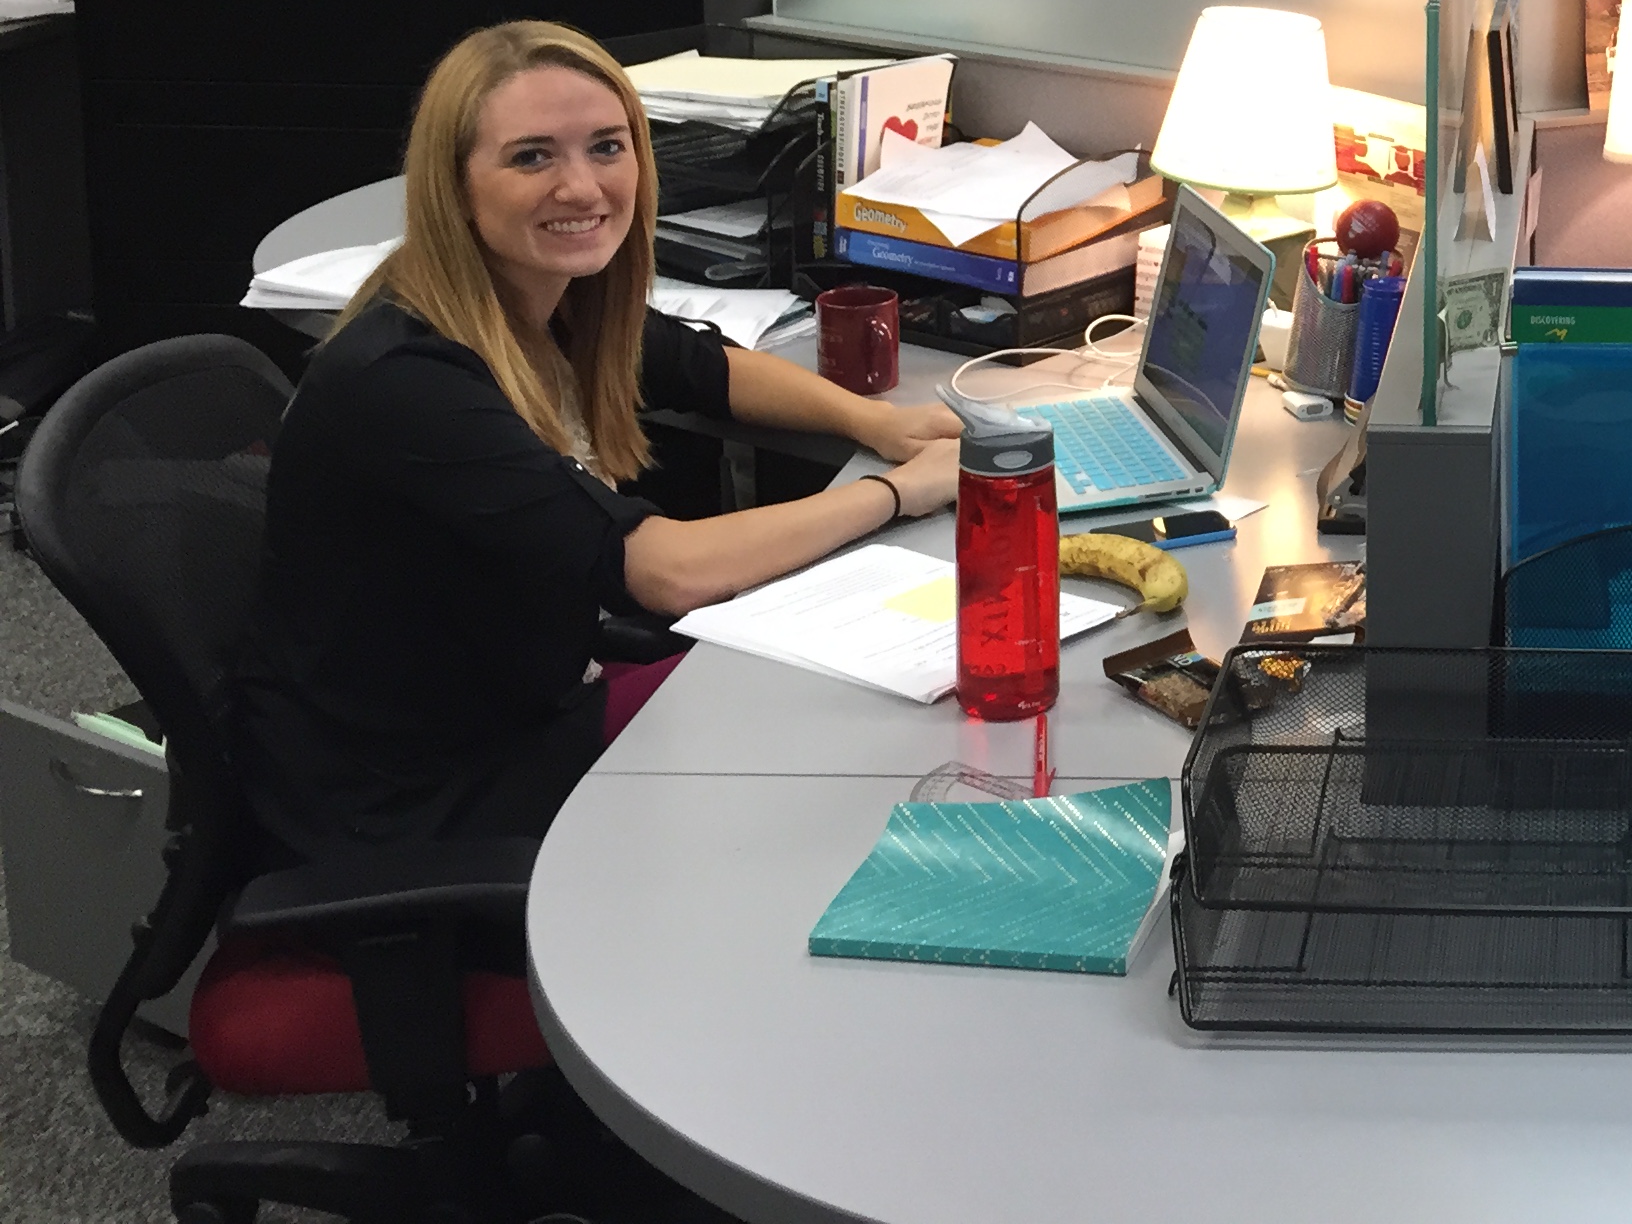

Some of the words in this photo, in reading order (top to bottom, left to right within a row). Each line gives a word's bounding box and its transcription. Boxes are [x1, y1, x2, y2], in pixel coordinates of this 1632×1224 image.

[854, 202, 907, 233] Geometry
[872, 247, 914, 268] Geometry
[1530, 315, 1576, 325] DISCOVERING
